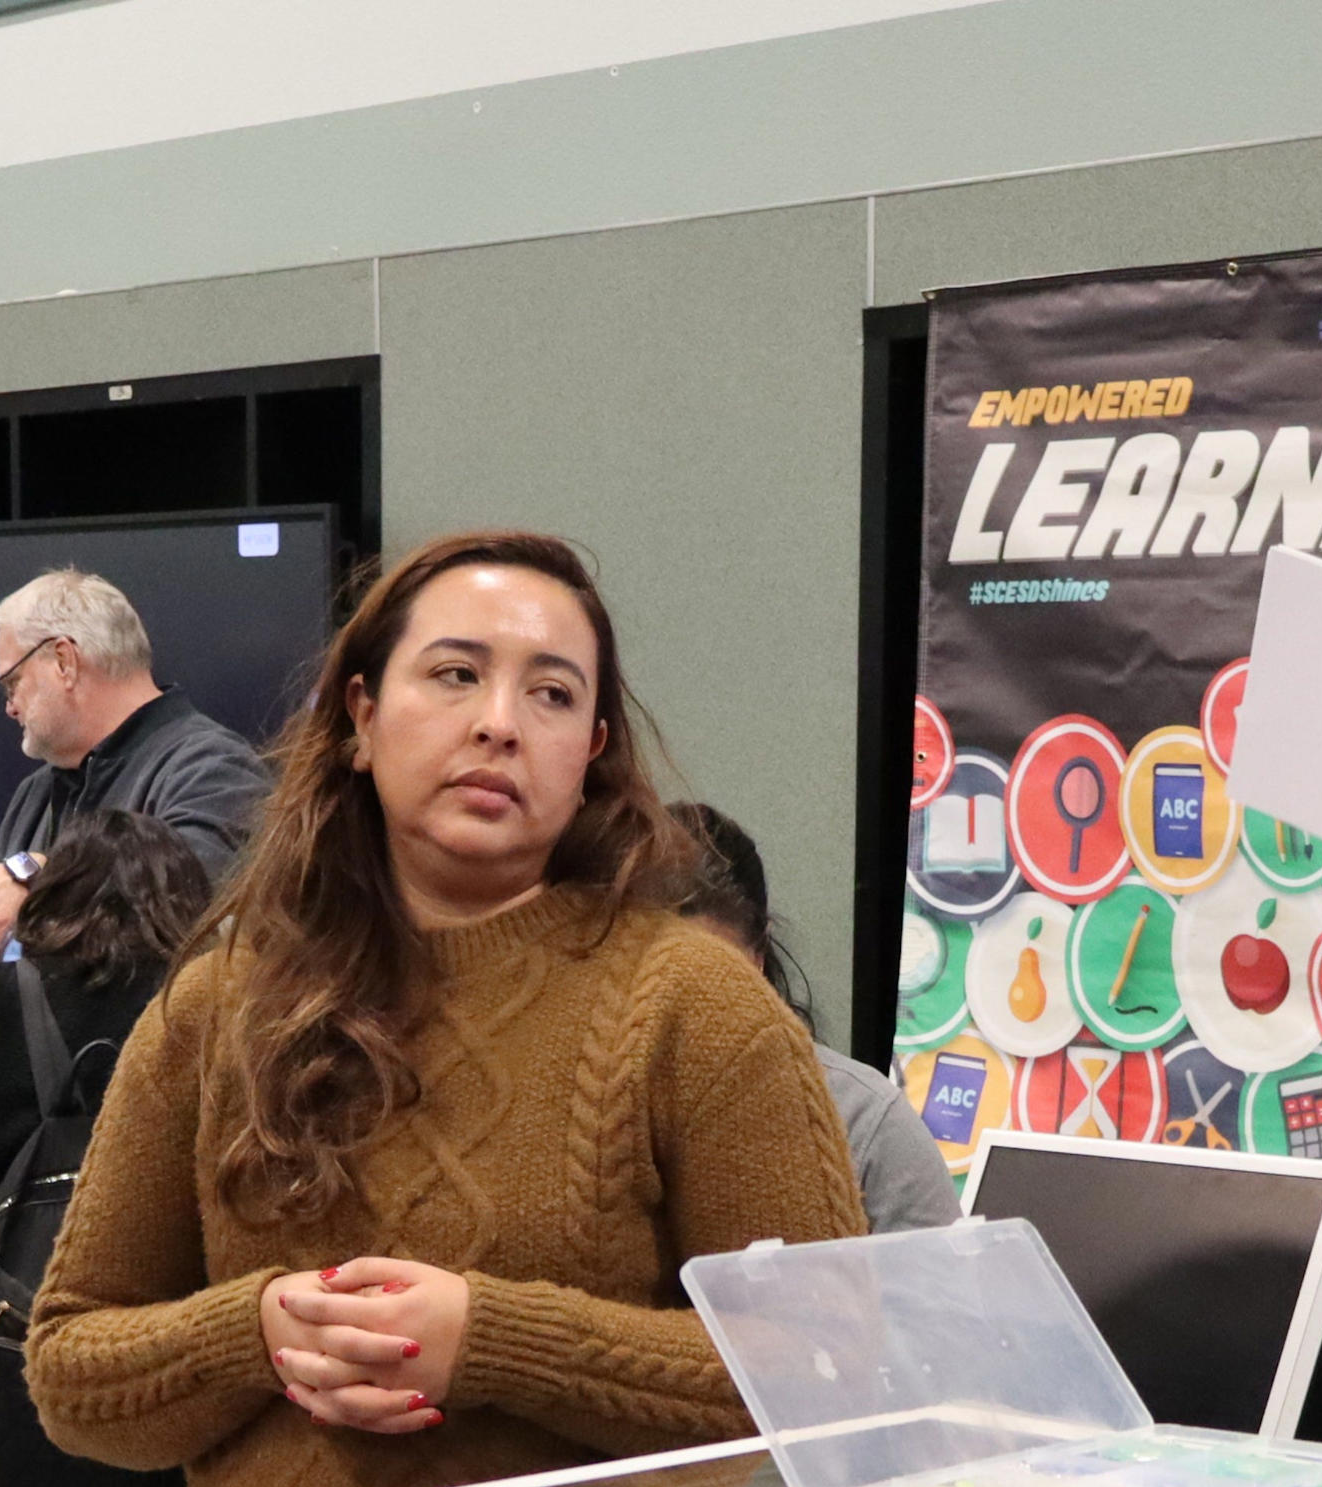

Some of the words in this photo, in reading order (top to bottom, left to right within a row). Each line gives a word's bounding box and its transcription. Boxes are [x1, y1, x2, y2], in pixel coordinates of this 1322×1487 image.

[968, 377, 1194, 428] EMPOWERED
[1160, 797, 1199, 820] ABC
[934, 1084, 977, 1109] ABC
